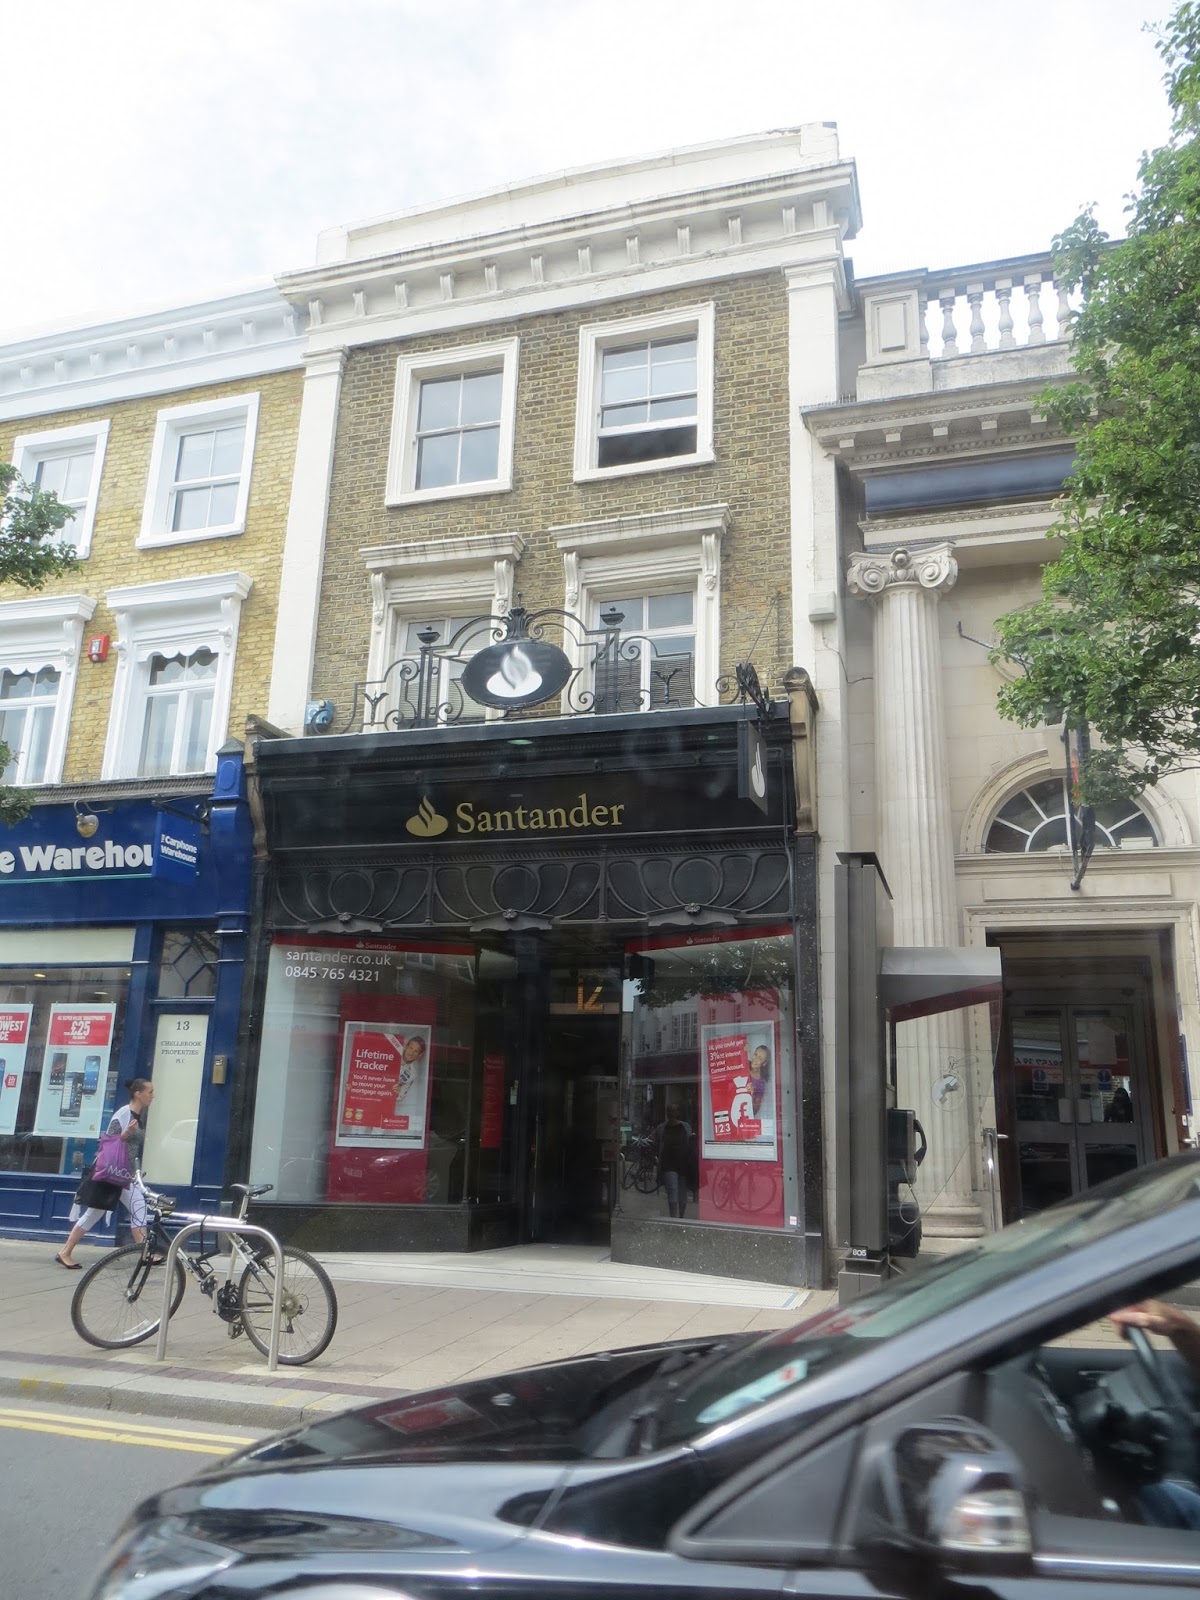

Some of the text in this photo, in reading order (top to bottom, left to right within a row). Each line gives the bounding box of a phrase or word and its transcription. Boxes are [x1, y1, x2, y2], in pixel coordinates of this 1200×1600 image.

[456, 793, 625, 834] Santander
[165, 836, 197, 854] Carphone
[161, 845, 197, 864] Warehouse
[693, 934, 720, 944] Santander
[365, 941, 397, 950] Santander
[286, 950, 391, 966] santander.co.uk
[285, 965, 380, 982] 0845 765 4321
[71, 1020, 91, 1036] £25
[176, 1020, 190, 1031] 13
[390, 1036, 401, 1049] NEW
[356, 1049, 395, 1061] Lifetime
[710, 1051, 720, 1060] 3%
[355, 1060, 388, 1071] Tracker
[726, 1063, 746, 1071] Account.
[852, 1248, 867, 1257] 805
